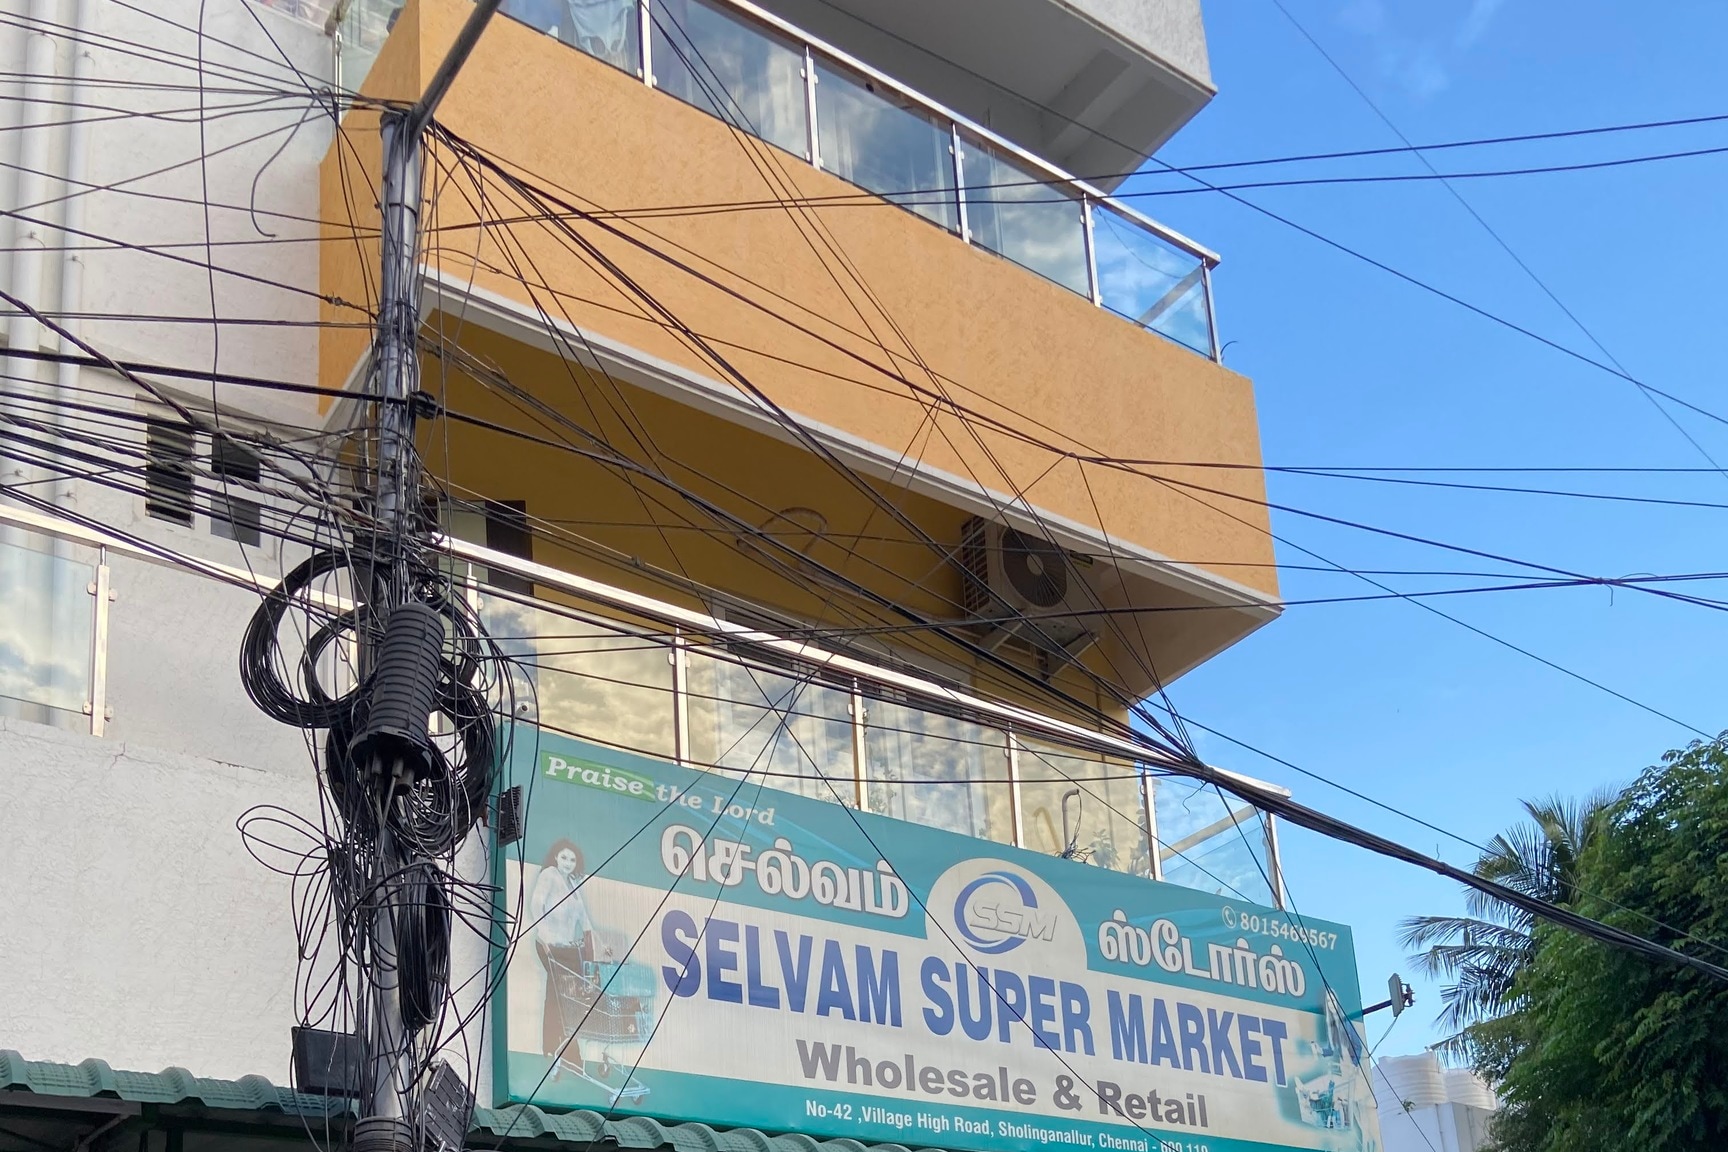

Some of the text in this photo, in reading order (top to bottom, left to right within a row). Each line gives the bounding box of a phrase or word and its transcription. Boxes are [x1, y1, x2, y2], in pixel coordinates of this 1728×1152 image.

[546, 757, 776, 826] Praise the Lord
[660, 824, 910, 919] செல்வம்
[969, 901, 1058, 942] SSM
[1097, 909, 1306, 997] ஸ்டோர்ஸ்
[1240, 912, 1337, 951] 8015469567
[661, 909, 1289, 1088] SELVAM SUPER MARKET
[796, 1039, 1210, 1128] Wholesale & Retail
[917, 1112, 950, 1134] High
[954, 1117, 995, 1138] Road,
[998, 1121, 1096, 1149] Sholinganallur,
[1098, 1132, 1149, 1152] Chennai
